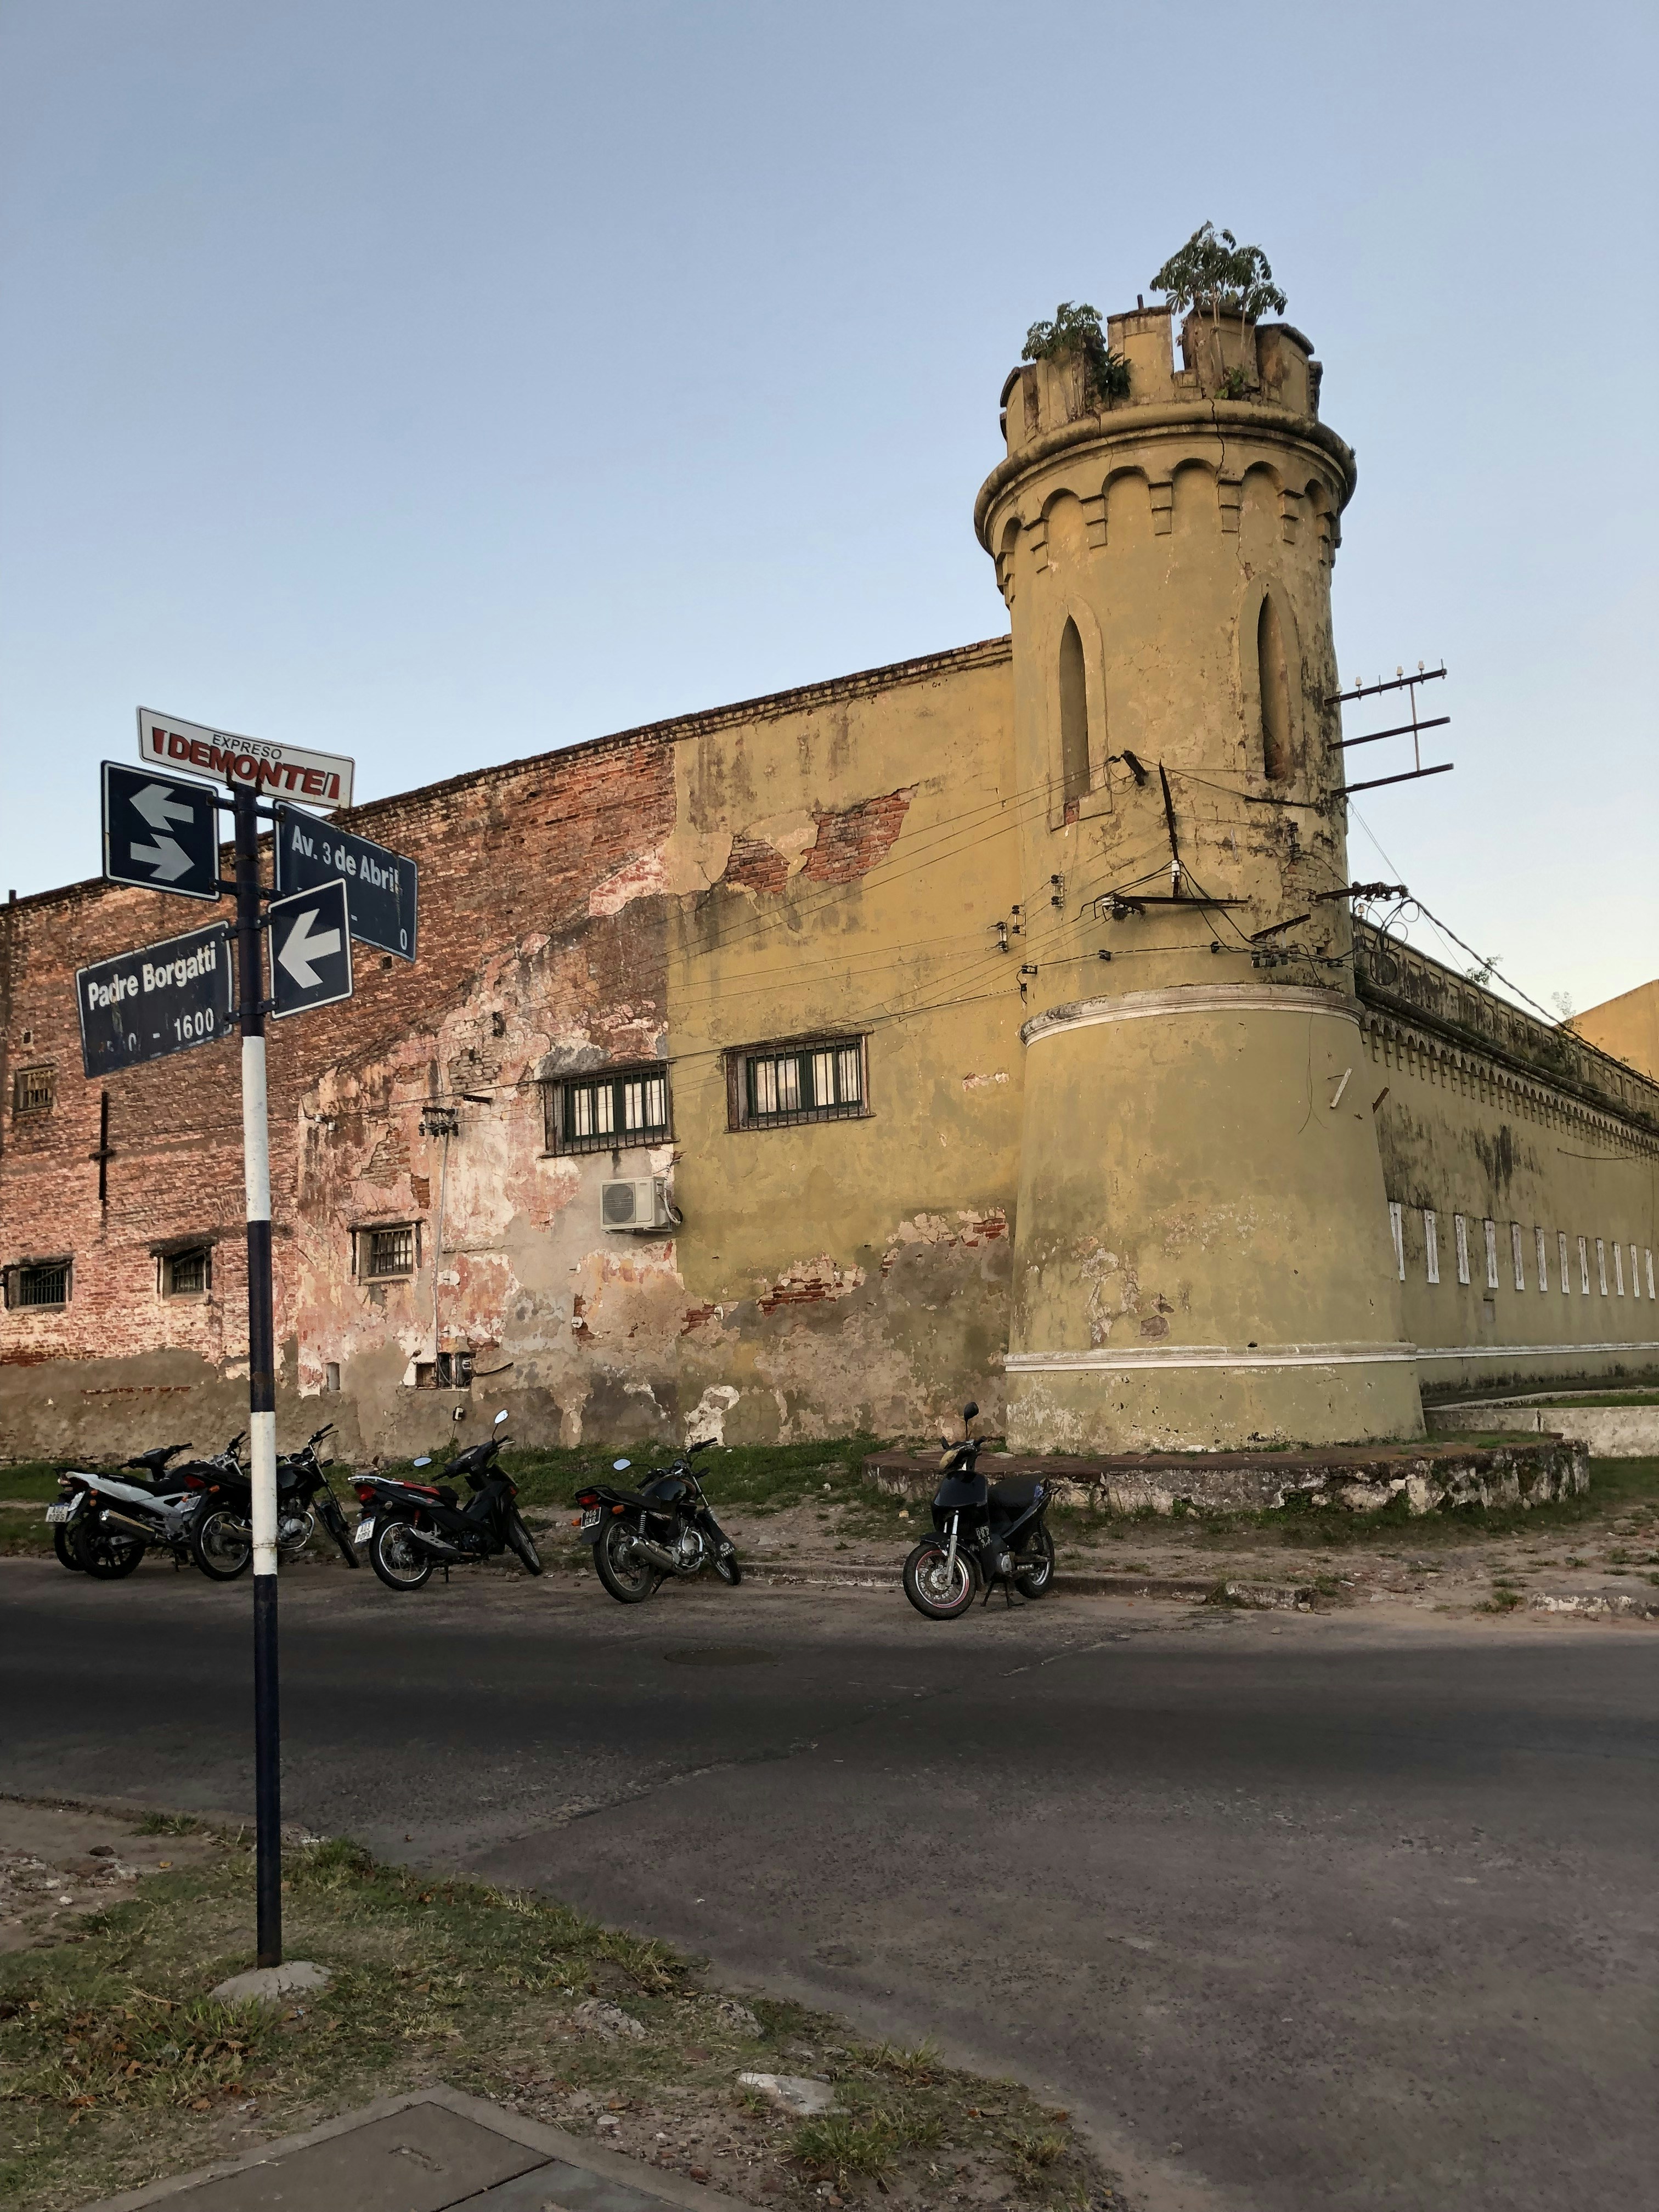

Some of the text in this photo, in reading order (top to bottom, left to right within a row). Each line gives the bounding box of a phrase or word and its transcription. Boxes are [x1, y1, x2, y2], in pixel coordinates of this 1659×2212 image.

[168, 732, 326, 796] DEMONTE
[212, 733, 282, 760] EXPRESO
[291, 825, 399, 895] Av. 3 de Abril
[400, 928, 408, 950] 0
[88, 941, 216, 1011] Padre Borgatti
[173, 1008, 214, 1041] 1600
